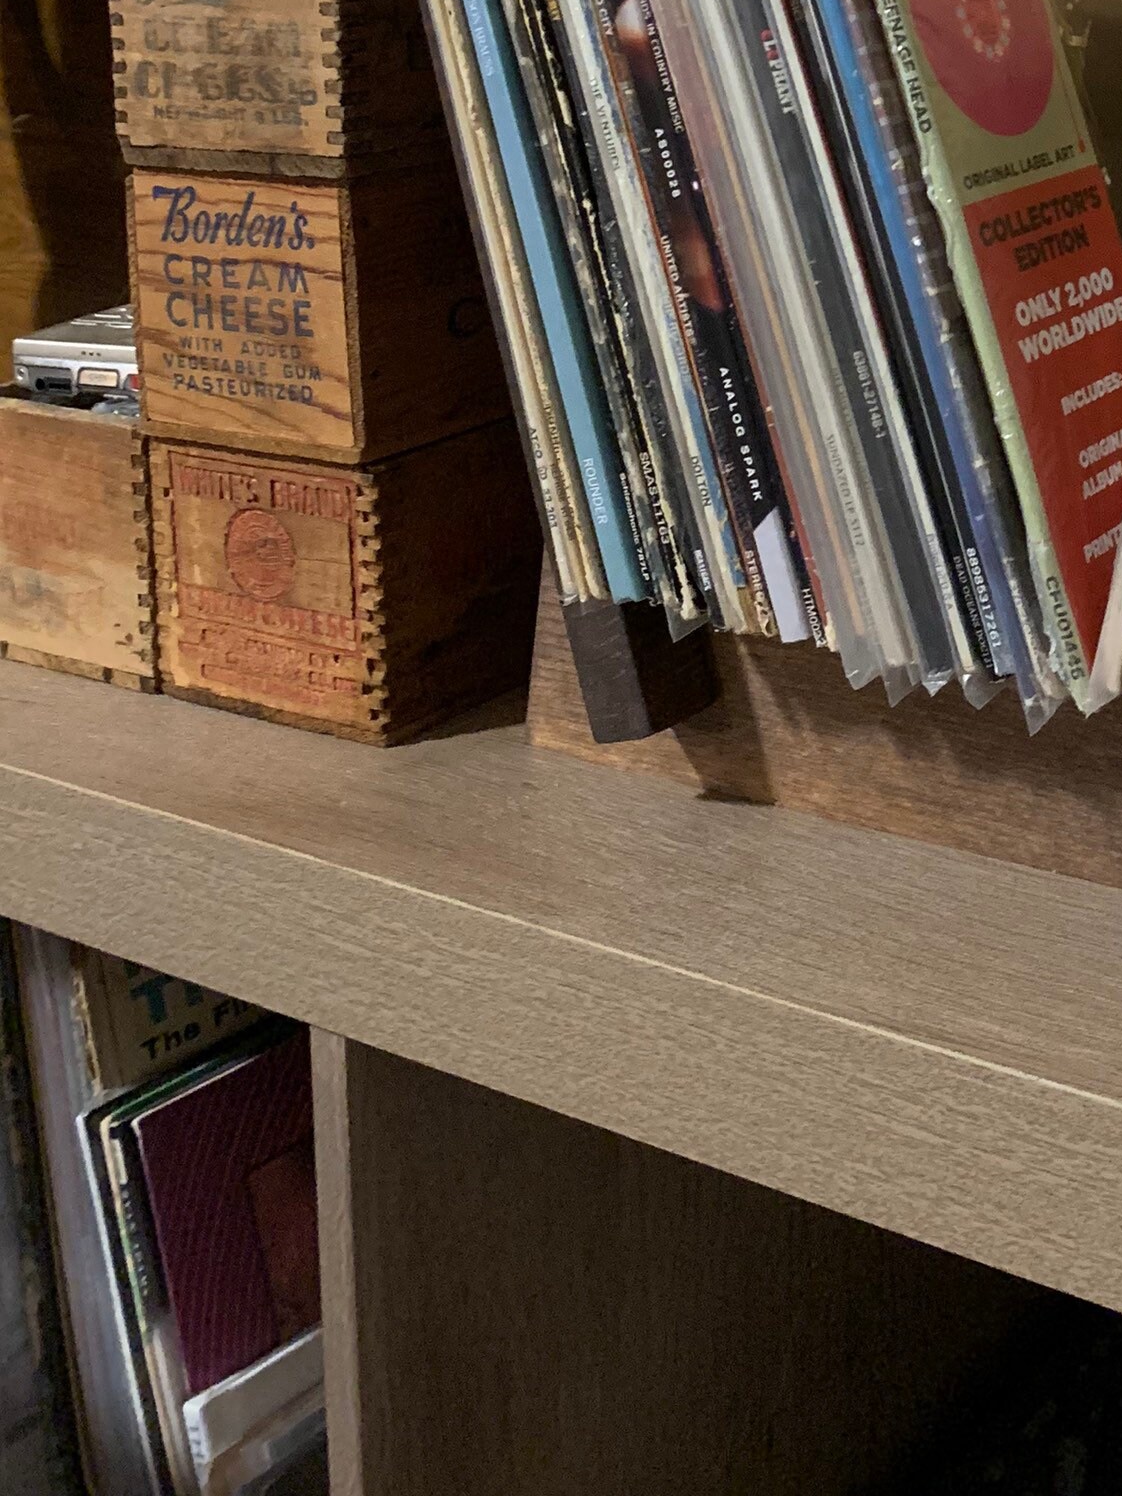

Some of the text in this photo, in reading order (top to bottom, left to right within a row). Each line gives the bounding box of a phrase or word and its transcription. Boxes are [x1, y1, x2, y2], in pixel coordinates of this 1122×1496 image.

[598, 7, 613, 37] CITY
[645, 22, 656, 36] IN
[474, 26, 495, 76] KRAUSS
[648, 38, 672, 93] COUNTRY
[665, 95, 684, 134] MUSIC
[905, 76, 933, 135] HEAD
[596, 104, 622, 171] VENTURES
[963, 145, 1075, 191] ORIGINAL LABEL ART
[151, 185, 316, 250] Borden's
[979, 186, 1101, 247] COLLECTOR'S
[163, 254, 309, 293] CREAM
[1013, 223, 1090, 272] EDITION
[659, 234, 680, 282] UNITED
[673, 283, 695, 337] ARTISTS
[1015, 267, 1114, 328] ONLY 2,000
[166, 290, 315, 338] CHEESE
[162, 353, 321, 382] VEGETABLE GUM
[178, 336, 300, 360] WITH ADDED
[173, 372, 314, 404] PASTEURIZED
[718, 365, 763, 502] ANALOG SPARK
[583, 457, 607, 525] ROUNDER
[689, 455, 712, 508] DOLTON
[826, 433, 850, 497] SUNDAZED
[617, 471, 650, 581] Schizophonic 787LP
[743, 548, 765, 603] STEREO
[952, 554, 980, 627] DEAD OCEANS
[965, 546, 1002, 647] 88985317261
[140, 1021, 201, 1060] The
